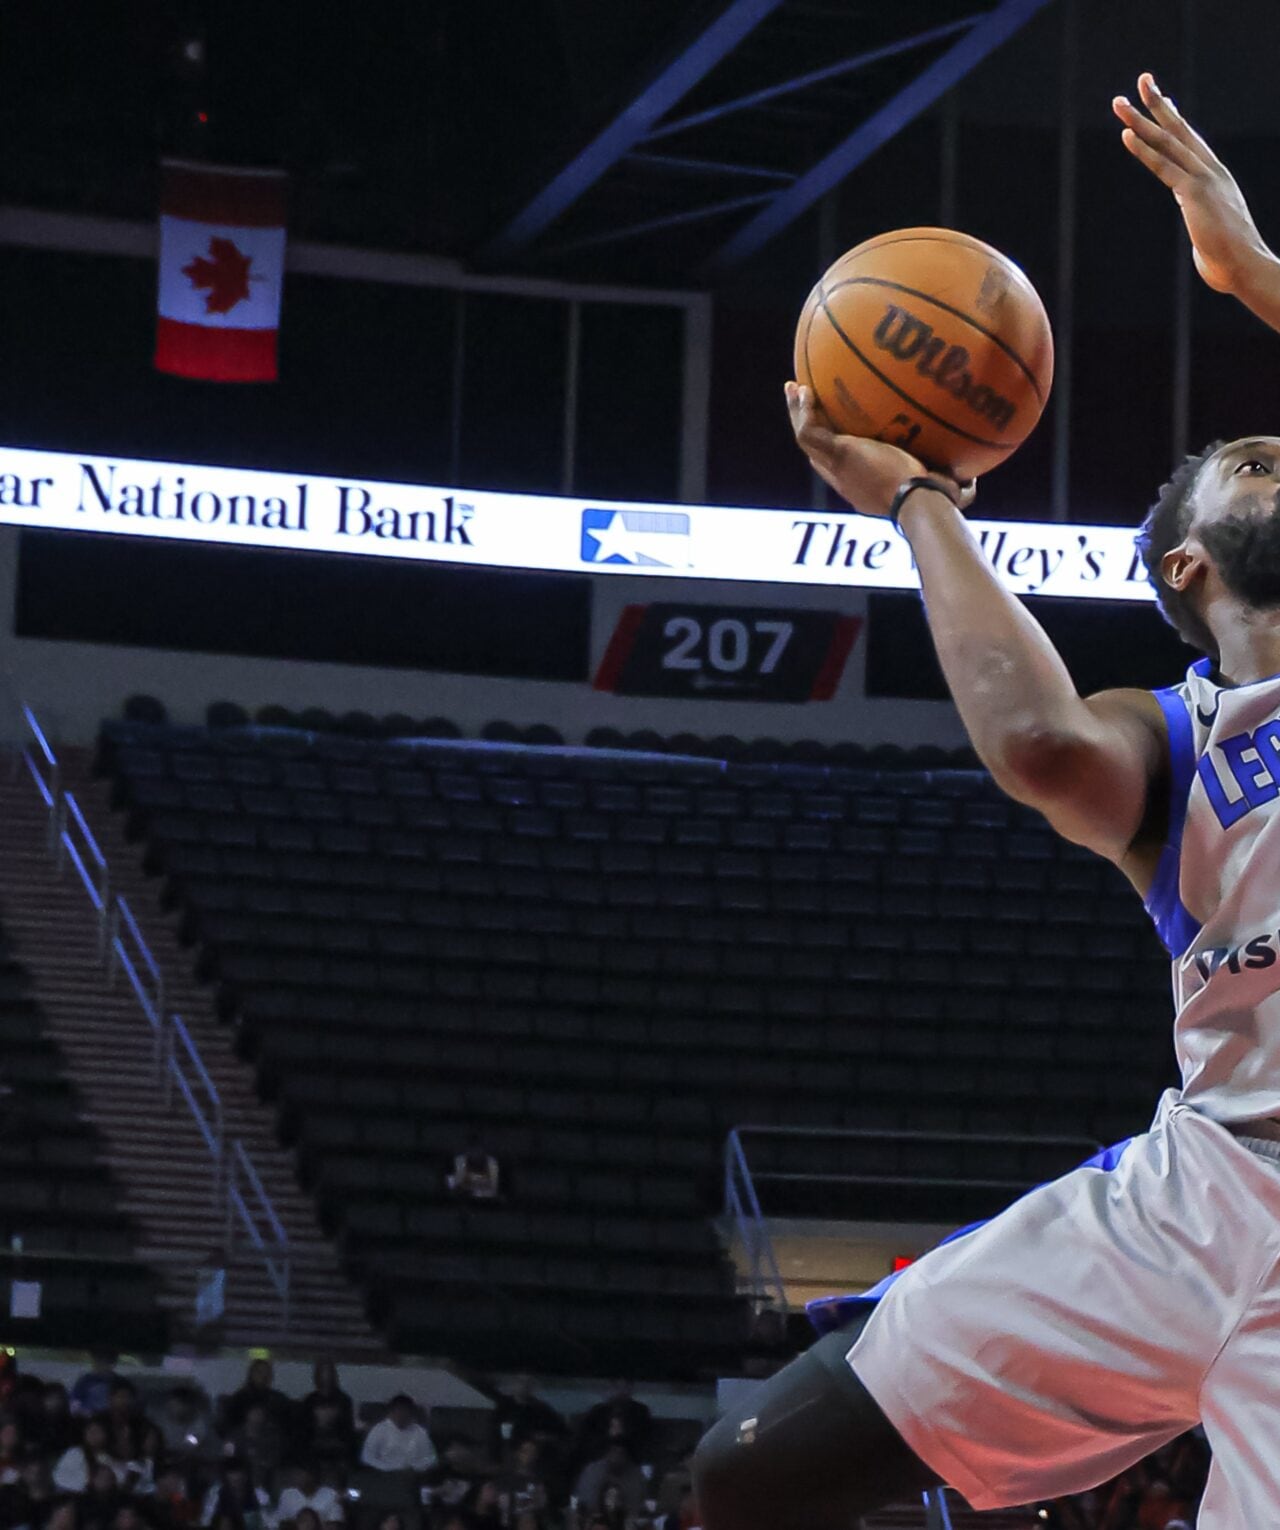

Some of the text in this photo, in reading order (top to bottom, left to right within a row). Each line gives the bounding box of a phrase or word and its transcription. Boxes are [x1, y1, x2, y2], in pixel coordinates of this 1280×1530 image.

[873, 304, 1016, 433] Wilson
[0, 463, 474, 546] ar National Bank
[791, 520, 891, 569] The
[661, 616, 794, 674] 207
